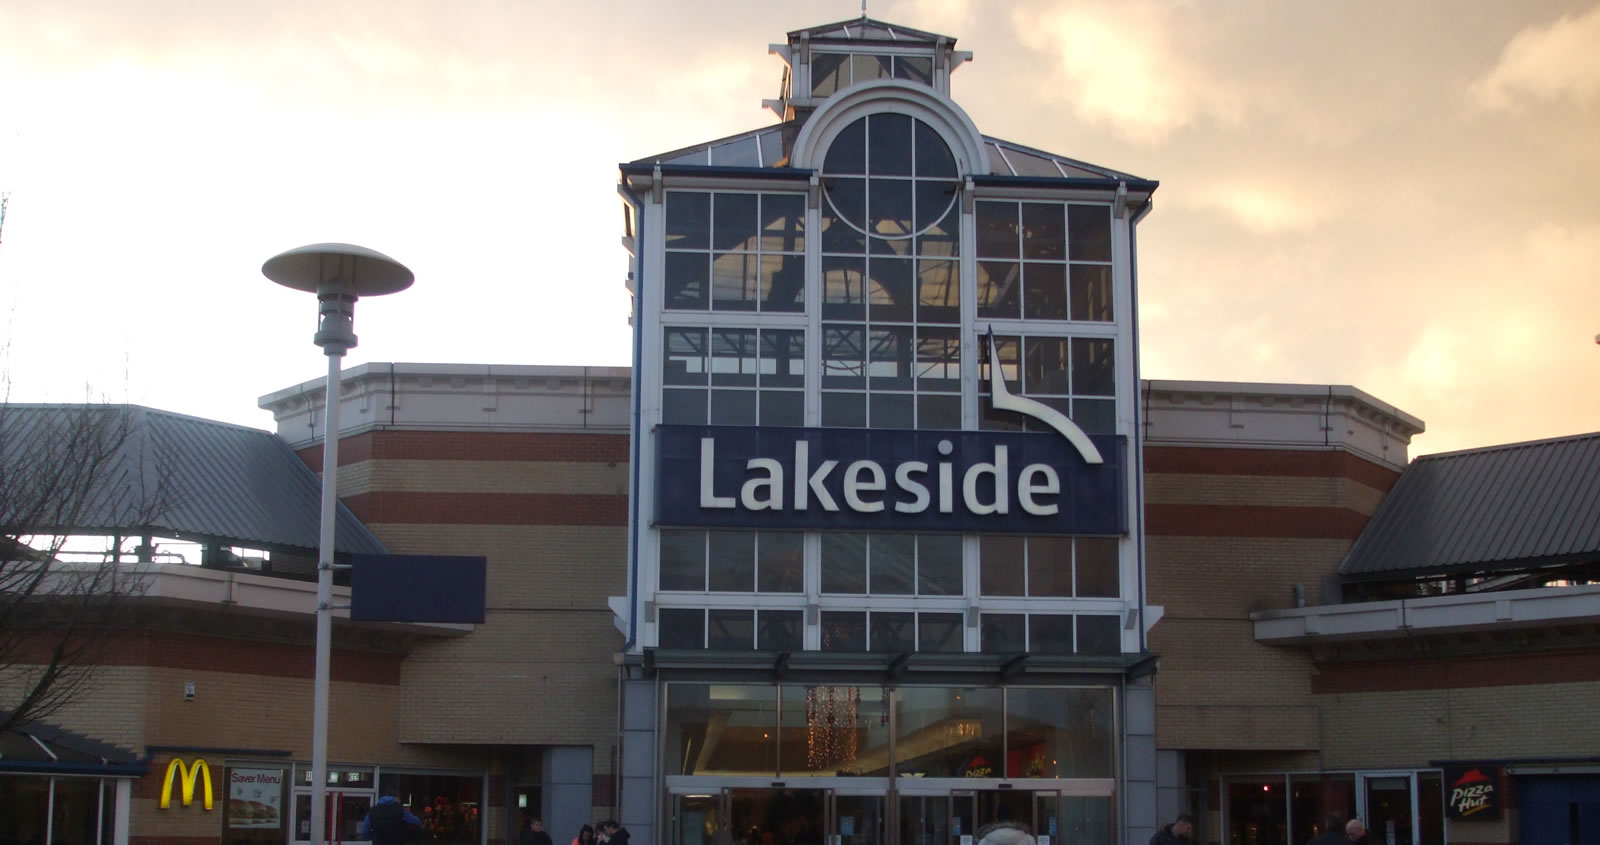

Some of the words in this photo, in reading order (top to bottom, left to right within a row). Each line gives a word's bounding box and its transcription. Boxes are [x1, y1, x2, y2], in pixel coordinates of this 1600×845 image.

[700, 437, 1061, 516] Lakeside
[160, 757, 214, 811] M
[231, 772, 256, 783] Saver
[256, 774, 280, 784] Menu
[1450, 785, 1494, 807] Pizza
[1458, 795, 1490, 813] Hut
